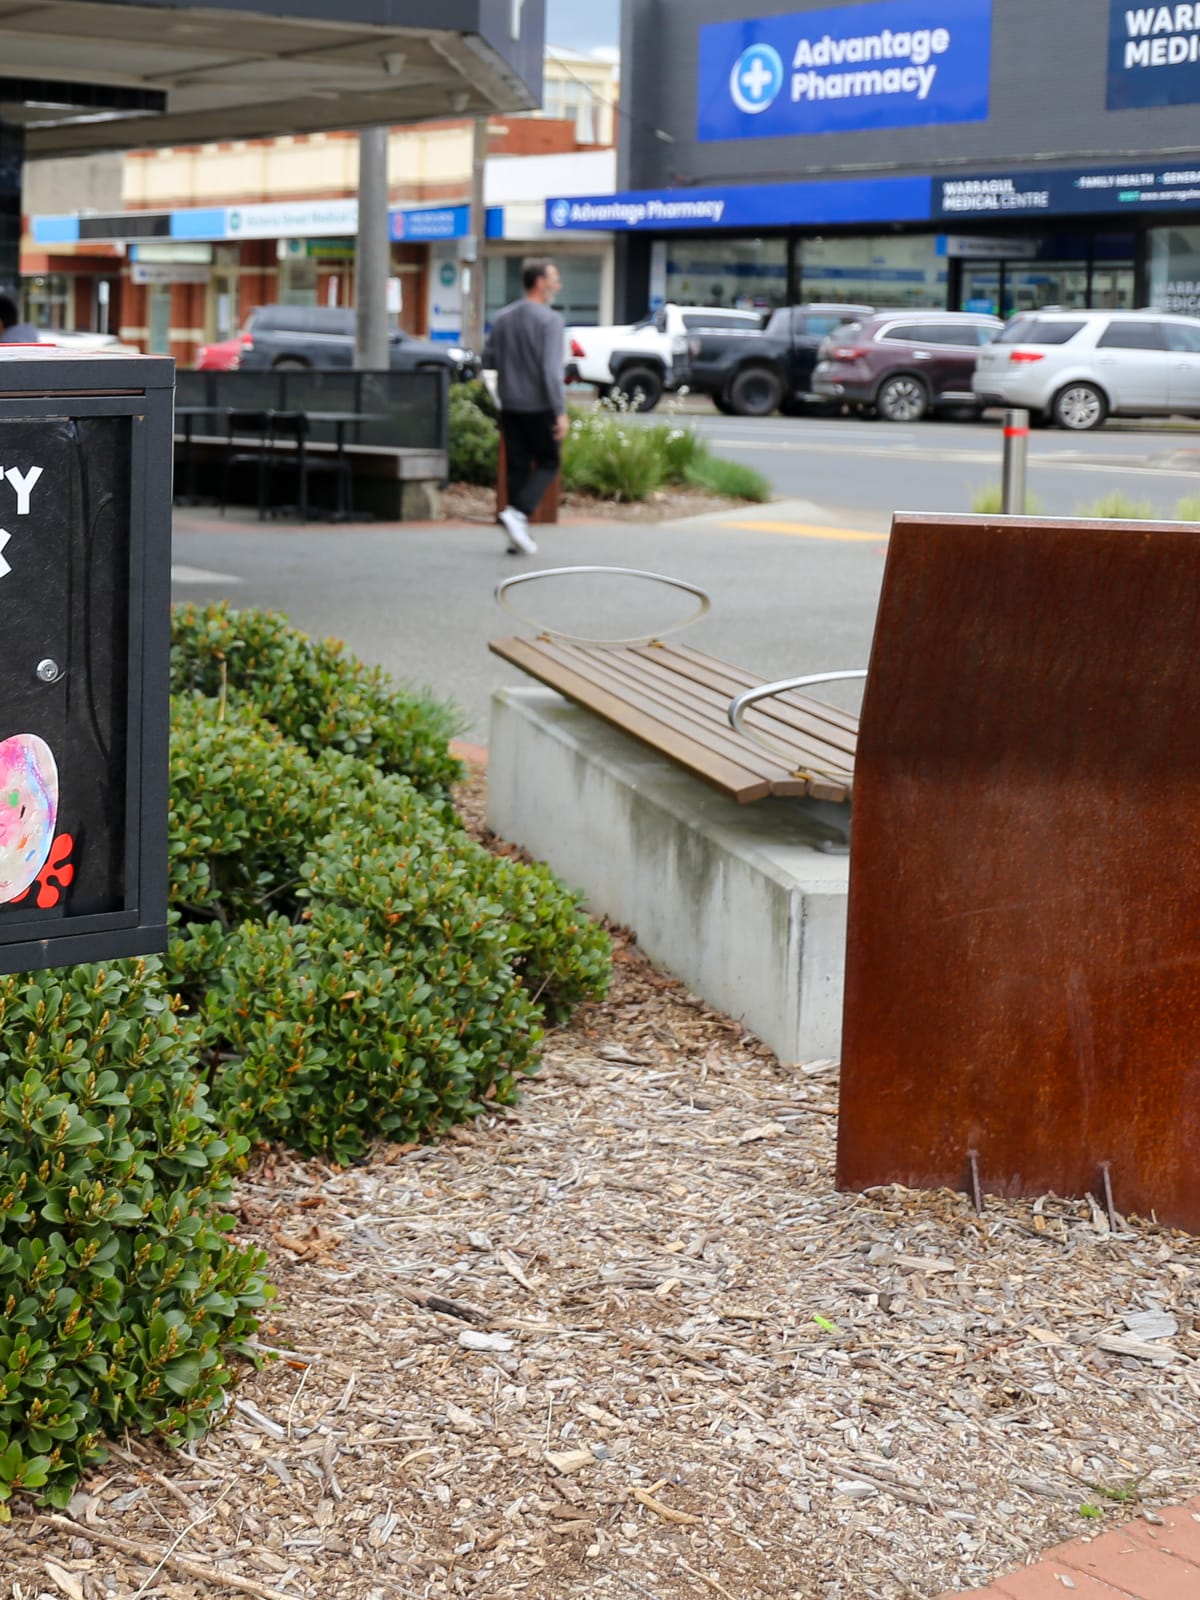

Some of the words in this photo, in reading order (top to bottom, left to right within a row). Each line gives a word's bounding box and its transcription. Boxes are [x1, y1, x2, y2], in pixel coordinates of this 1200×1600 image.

[793, 28, 950, 69] Advantage
[1124, 34, 1200, 69] MEDI
[791, 64, 937, 102] Pharmacy
[942, 179, 1015, 195] WARRAGUL
[1116, 173, 1155, 187] HEALTH
[570, 201, 647, 225] Advantage
[648, 200, 725, 222] Pharmacy
[942, 193, 999, 211] MEDICAL
[999, 191, 1049, 209] CENTRE
